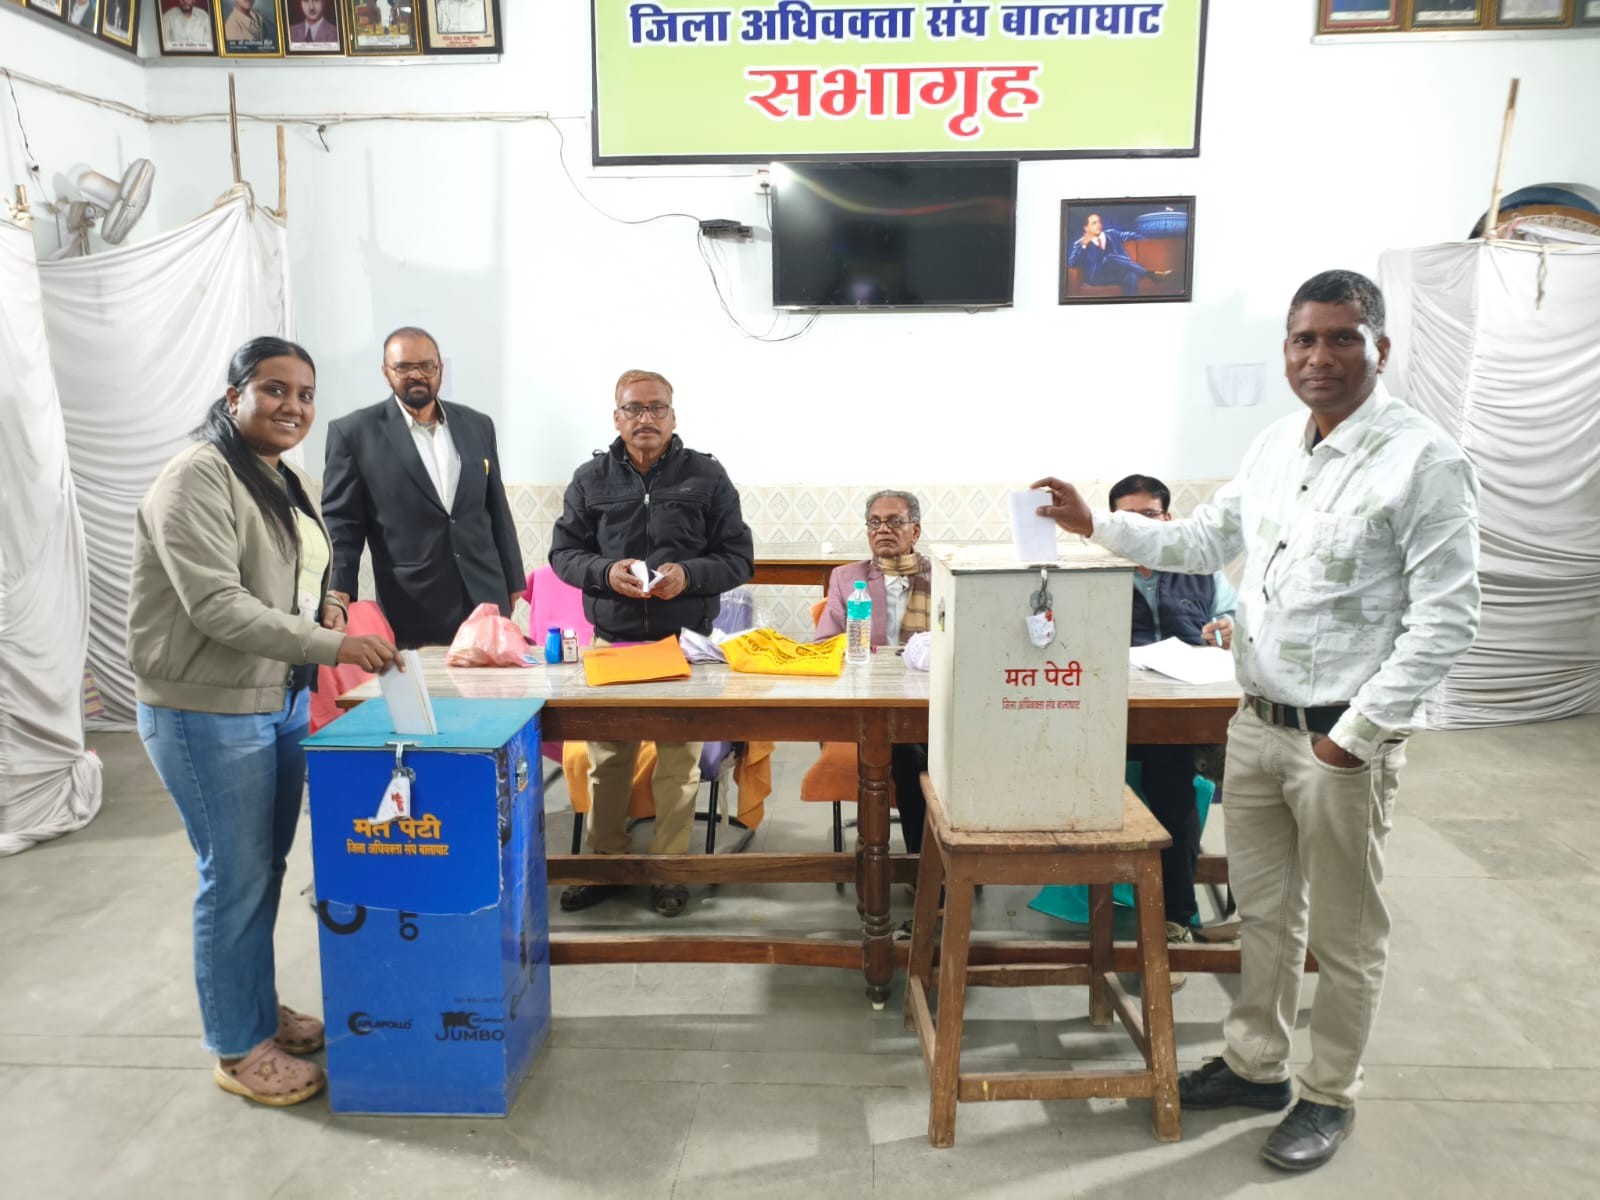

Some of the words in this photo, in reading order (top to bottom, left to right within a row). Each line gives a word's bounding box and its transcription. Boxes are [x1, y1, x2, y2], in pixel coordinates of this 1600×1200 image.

[630, 4, 731, 43] जिला
[741, 0, 915, 40] अधिवक्ता
[926, 0, 990, 37] संघ
[1000, 3, 1164, 36] बालाघाट
[748, 66, 1039, 136] सभागृह
[1004, 668, 1038, 686] मत
[1044, 660, 1083, 686] पेटी
[352, 819, 391, 838] मत
